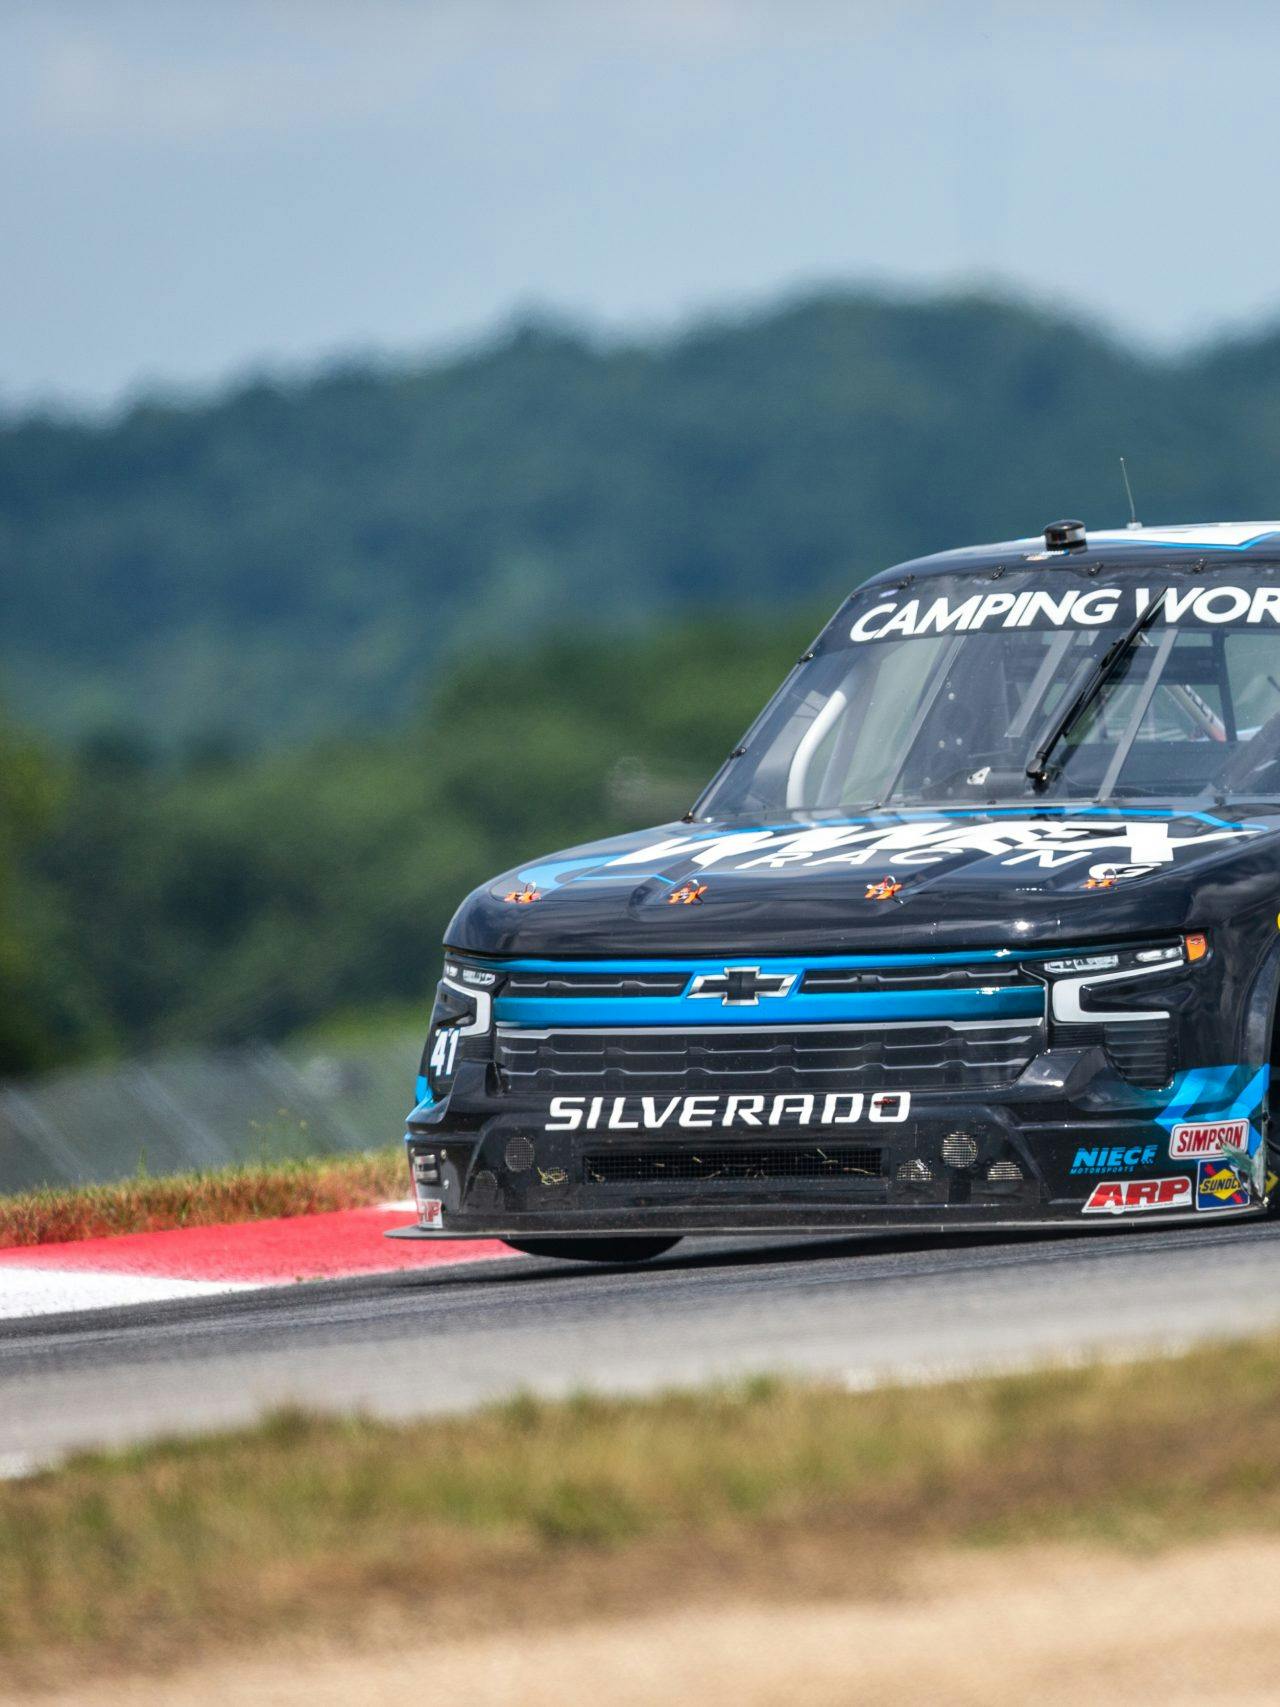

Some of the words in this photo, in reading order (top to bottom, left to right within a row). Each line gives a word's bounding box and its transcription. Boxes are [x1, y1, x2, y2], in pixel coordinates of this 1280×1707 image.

[849, 586, 1119, 643] CAMPING
[734, 847, 1162, 879] RACNG
[430, 1027, 461, 1077] 41
[544, 1091, 911, 1131] SILVERADO
[1177, 1125, 1244, 1153] SIMPSON
[1069, 1165, 1135, 1175] MOTORSPORTS
[1072, 1144, 1159, 1168] NIECE
[1088, 1178, 1191, 1208] ARP
[1201, 1178, 1242, 1193] SUNOC
